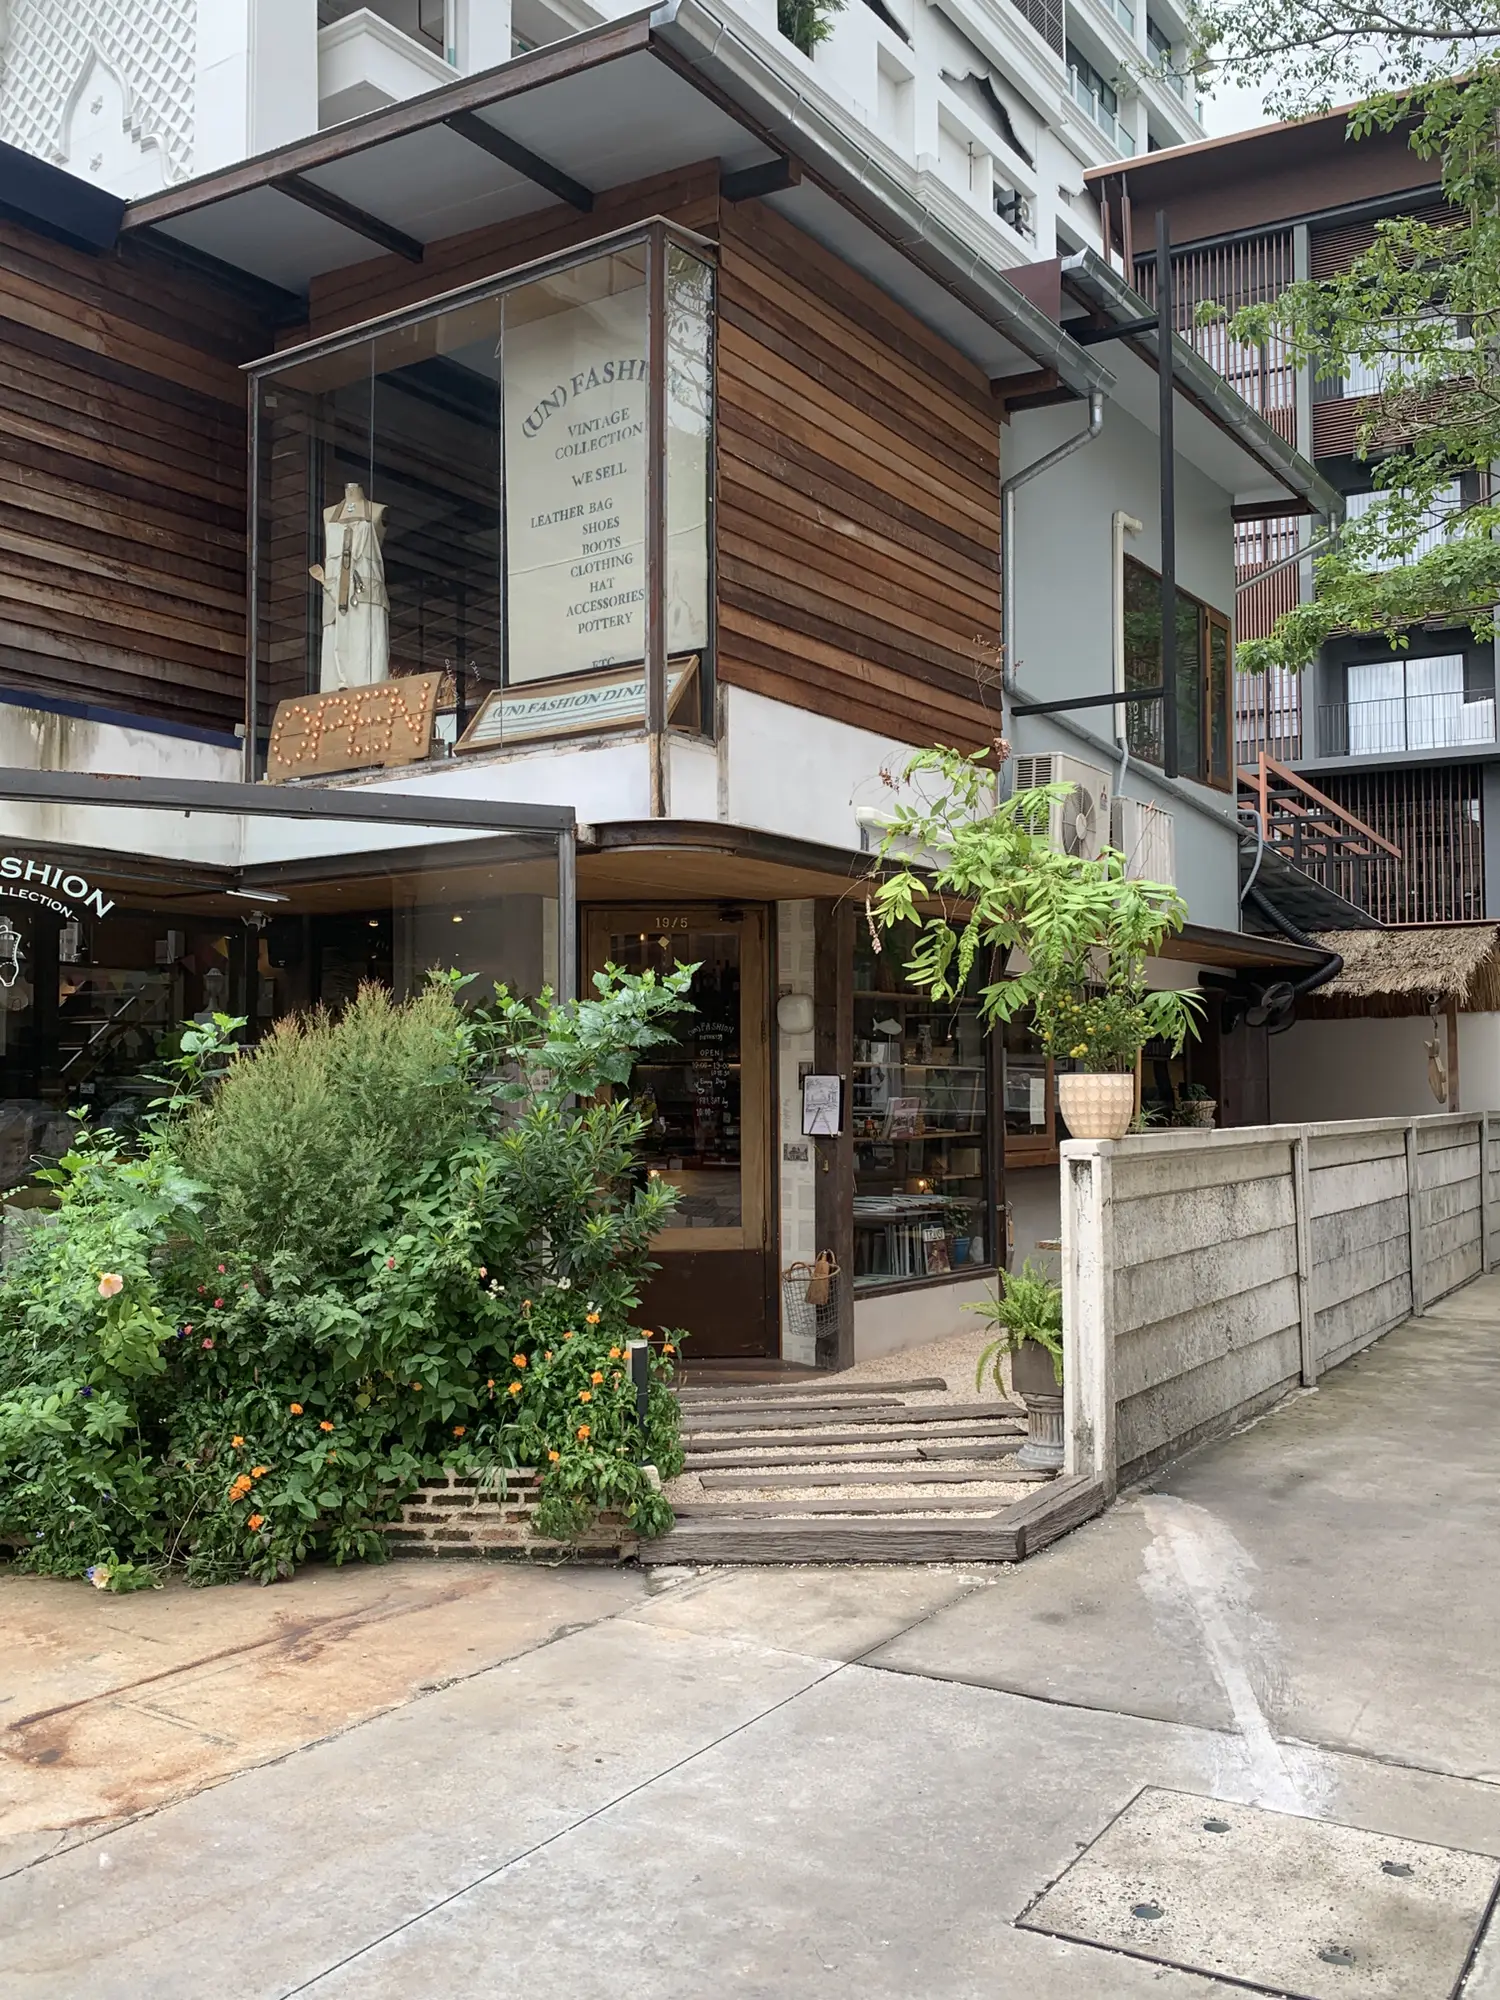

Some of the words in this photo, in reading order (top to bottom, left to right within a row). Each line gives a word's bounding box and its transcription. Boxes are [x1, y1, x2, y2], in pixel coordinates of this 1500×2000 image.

[568, 407, 631, 438] VINTAGE
[555, 422, 644, 460] COLLECTION
[571, 470, 594, 487] WE
[595, 462, 627, 481] SELL
[530, 504, 585, 529] LEATHER
[588, 497, 614, 514] BAG
[582, 516, 620, 535] SHOES
[581, 536, 622, 556] BOOTS
[570, 552, 634, 578] CLOTHING
[589, 577, 615, 593] HAT
[566, 588, 645, 618] ACCESSORIES
[578, 611, 634, 634] POTTERY
[528, 692, 600, 715] FASHION
[274, 681, 430, 767] OPEN
[655, 916, 689, 929] 19/5
[699, 1048, 720, 1057] OPEN
